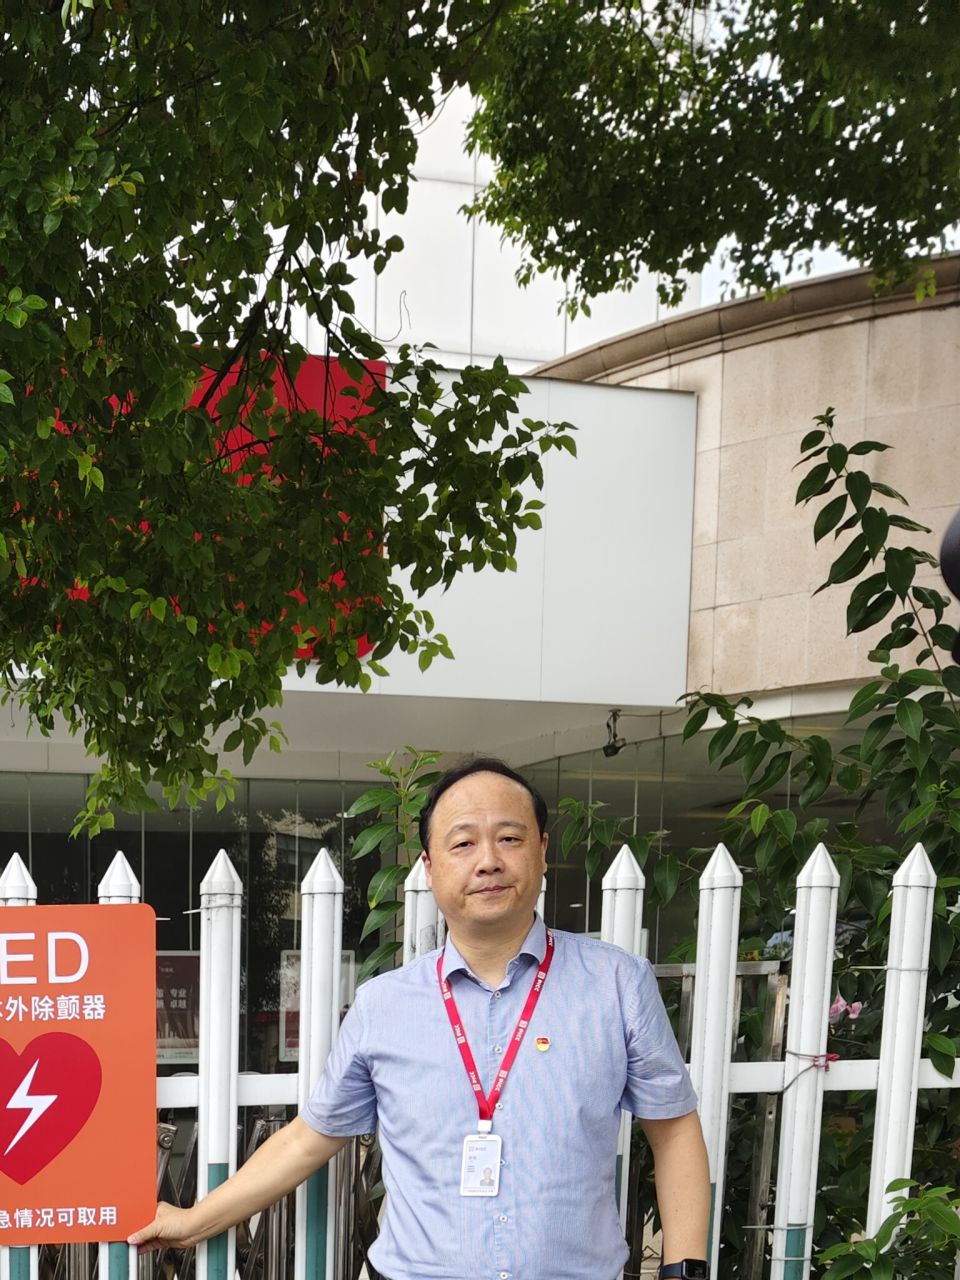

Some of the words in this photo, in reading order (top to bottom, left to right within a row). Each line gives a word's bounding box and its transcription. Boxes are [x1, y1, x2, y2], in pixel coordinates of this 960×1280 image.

[534, 979, 545, 992] PICC
[454, 1024, 463, 1037] PICC
[514, 1028, 524, 1042] PICC
[495, 1078, 506, 1092] PICC
